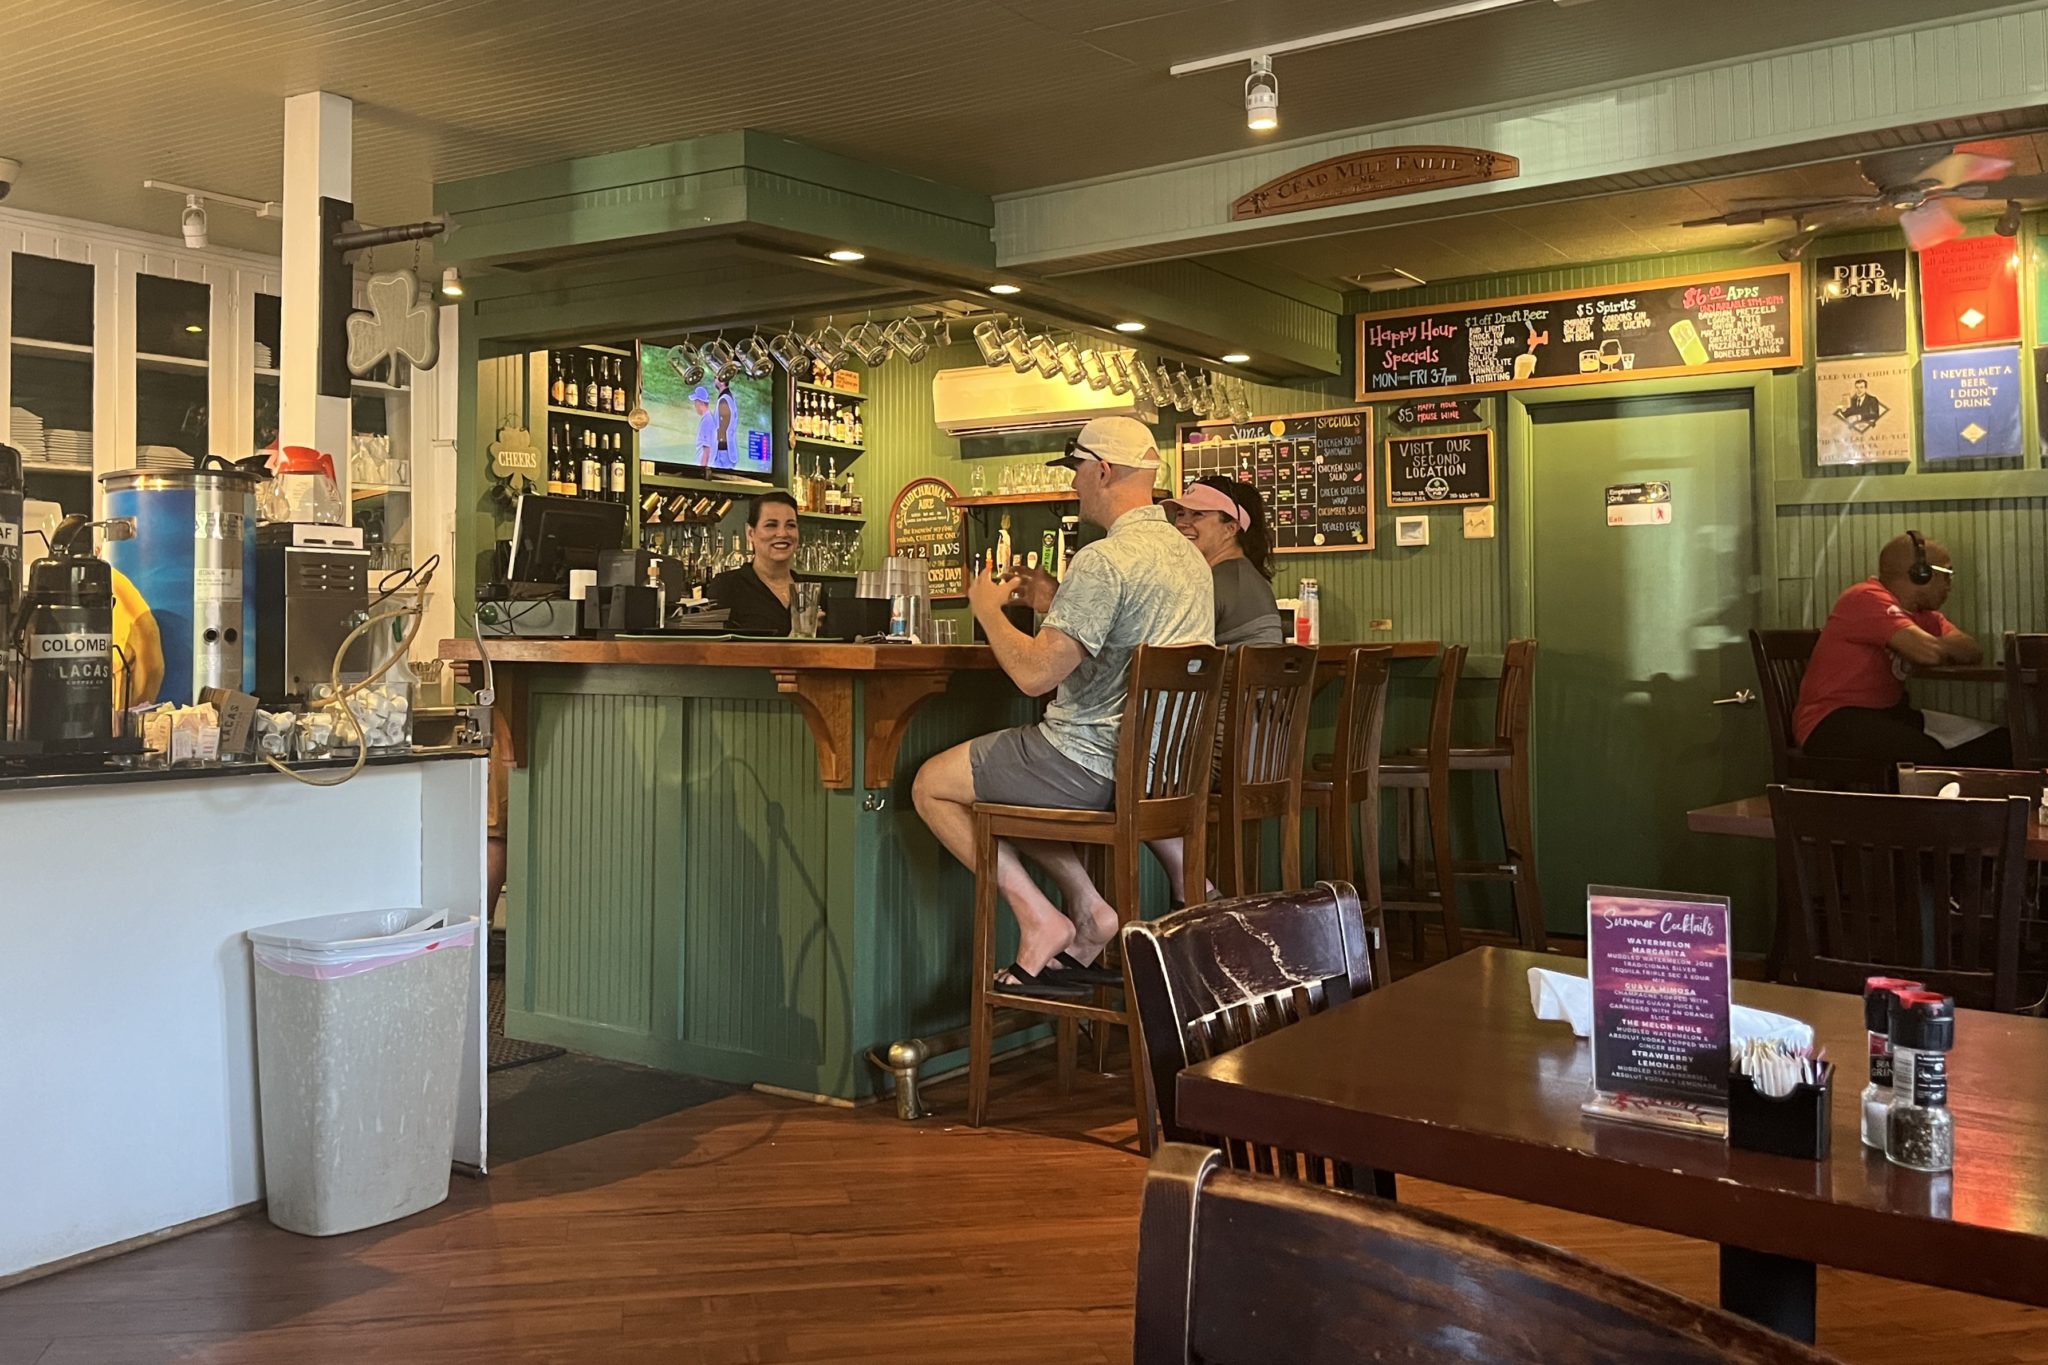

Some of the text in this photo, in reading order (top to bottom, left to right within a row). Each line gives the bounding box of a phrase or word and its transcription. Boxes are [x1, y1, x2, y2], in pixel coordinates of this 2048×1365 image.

[1834, 263, 1885, 281] PUB
[1576, 298, 1636, 317] $5 Spirits
[1495, 310, 1521, 324] Draft
[1523, 309, 1549, 321] Beer
[1369, 318, 1458, 349] Happy Hour
[1382, 345, 1439, 370] Specials
[1475, 372, 1510, 383] ROTATING
[1940, 368, 1976, 379] NEVER
[1978, 366, 2002, 376] MET
[2003, 365, 2012, 375] A
[1961, 378, 1988, 388] BEER
[1958, 386, 1998, 398] DIDN'T
[1954, 398, 1991, 408] DRINK
[1318, 414, 1361, 429] SPECIALS
[1397, 408, 1414, 422] $5
[1441, 410, 1460, 420] WINE
[1318, 436, 1363, 448] CHICKEN SALAD
[1400, 439, 1471, 457] VISIT OUR
[498, 450, 537, 468] CHEERS
[1412, 453, 1460, 467] SECOND
[1318, 463, 1343, 473] CHICKEN
[1344, 461, 1363, 472] SALAD
[1406, 463, 1466, 479] LOCATION
[1329, 472, 1348, 482] SALAD
[933, 543, 960, 556] DAYS
[59, 664, 109, 679] LACAS
[222, 704, 240, 743] LACAS
[1603, 908, 1714, 936] Summer Cocktails
[1627, 937, 1691, 949] WATERMELON
[1607, 953, 1641, 961] MUDDLED
[1632, 947, 1686, 957] MARGARITA
[1624, 961, 1697, 973] TRADICIONAL SILVER
[1690, 974, 1710, 982] SOUR
[1625, 982, 1697, 996] GUAVA MIMOSA
[1614, 990, 1657, 1000] CHAMPAGNE
[1660, 994, 1688, 1002] TOPPED
[1622, 997, 1644, 1005] FRESH
[1646, 1000, 1671, 1008] GUAVA
[1609, 1003, 1650, 1012] GARNISHED
[1684, 1011, 1715, 1020] ORANGE
[1621, 1019, 1639, 1027] THE
[1616, 1026, 1650, 1035] MUDDLED
[1652, 1031, 1701, 1041] WATERMELON
[1608, 1033, 1640, 1041] ABSOLUT
[1641, 1036, 1666, 1044] VODKA
[1668, 1039, 1697, 1048] TOPPED
[1638, 1042, 1665, 1051] GINGER
[1632, 1049, 1694, 1062] STRAWBERRY
[1617, 1065, 1651, 1075] MUDDLED
[1637, 1059, 1688, 1071] LEMONADE
[1611, 1071, 1642, 1080] ABSOLUT
